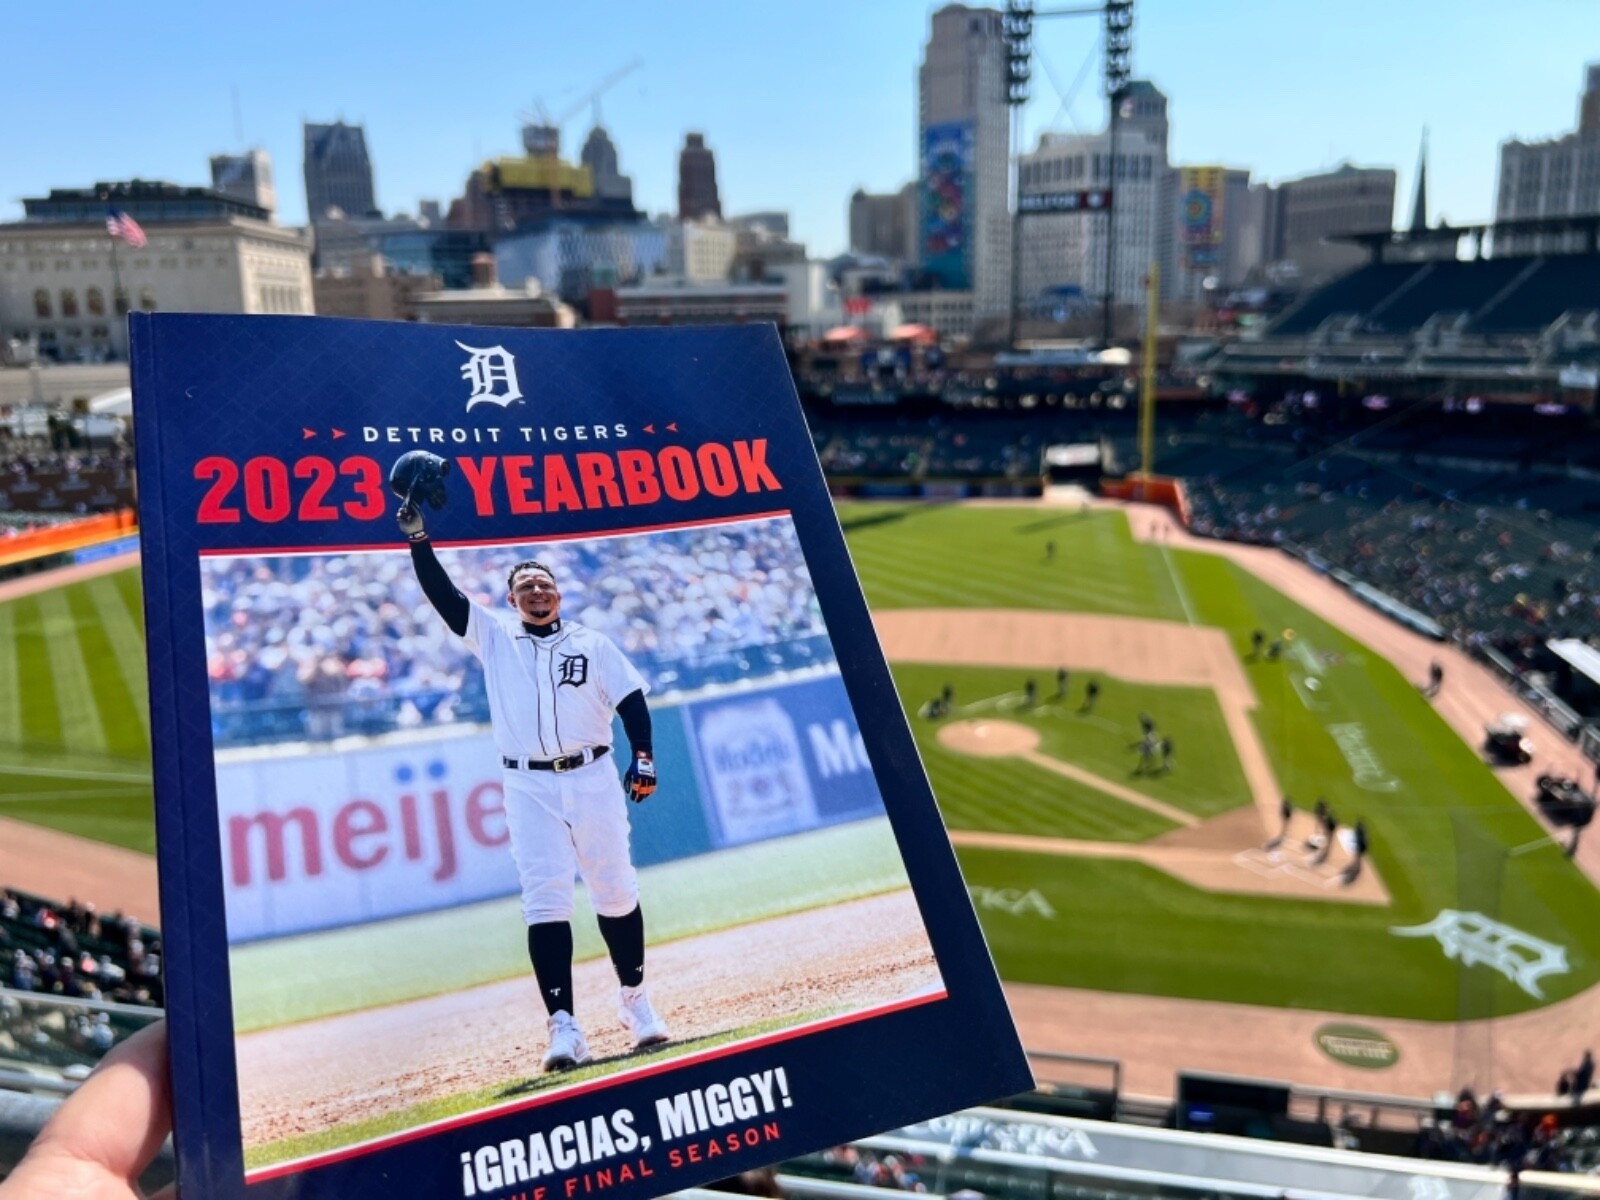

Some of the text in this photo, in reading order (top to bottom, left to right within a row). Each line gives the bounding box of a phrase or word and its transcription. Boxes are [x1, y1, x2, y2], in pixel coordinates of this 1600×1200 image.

[363, 424, 628, 442] DETROIT TIGERS
[193, 439, 783, 523] 2023 YEARBOOK
[655, 1067, 793, 1142] MIGGY!
[565, 1122, 781, 1198] FINAL SEASON
